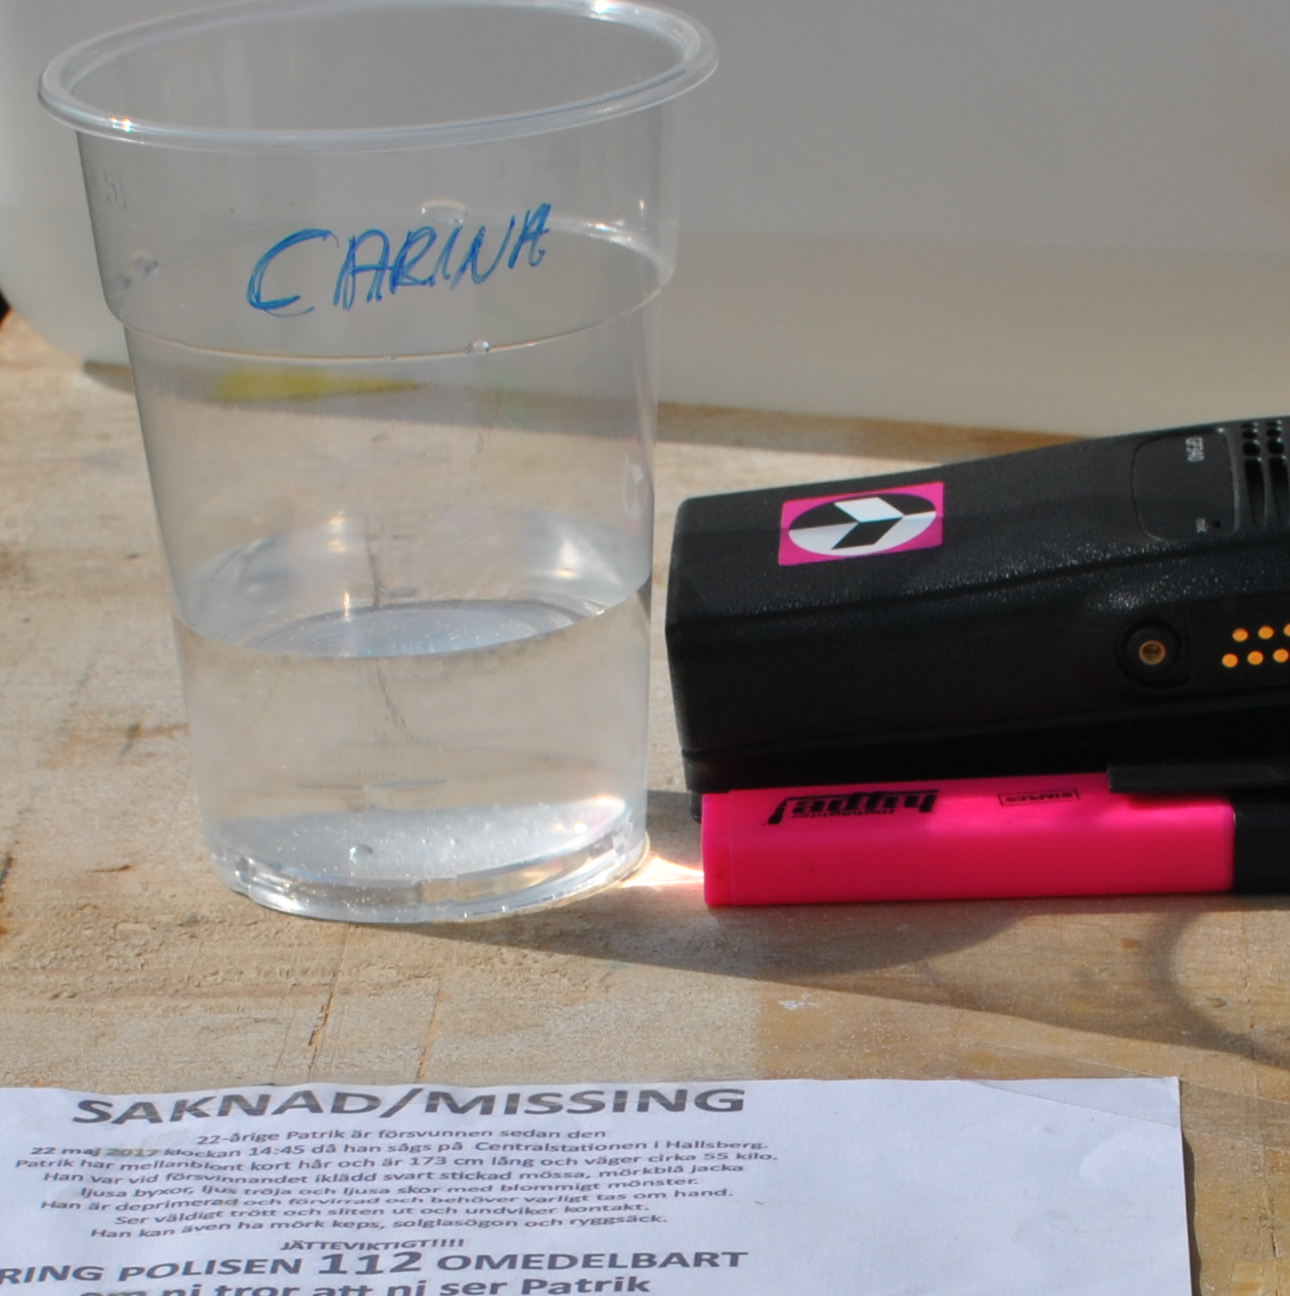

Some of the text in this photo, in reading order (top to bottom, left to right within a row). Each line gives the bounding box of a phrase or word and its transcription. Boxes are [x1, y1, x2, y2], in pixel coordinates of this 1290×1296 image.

[246, 203, 551, 317] CARINA
[72, 1087, 746, 1125] SAKNAD/MISSING
[197, 1129, 606, 1145] 22-årige Patrik är försvunnen sedan den
[30, 1147, 56, 1155] 22
[62, 1148, 102, 1156] maj
[106, 1148, 159, 1157] 2017
[164, 1148, 241, 1158] klockan
[248, 1146, 305, 1156] 14:45
[311, 1145, 337, 1154] då
[344, 1144, 382, 1153] han
[387, 1143, 432, 1154] sågs
[438, 1143, 463, 1153] på
[474, 1142, 647, 1152] Centralstationen
[665, 1140, 768, 1150] Hallsberg.
[15, 1159, 74, 1168] Patrik
[80, 1160, 114, 1169] har
[120, 1161, 243, 1171] mellanblont
[250, 1161, 291, 1171] kort
[298, 1160, 333, 1169] hår
[338, 1159, 375, 1168] och
[382, 1158, 403, 1167] är
[409, 1157, 447, 1166] 173
[454, 1158, 484, 1166] cm
[491, 1156, 535, 1168] lång
[541, 1157, 578, 1166] och
[584, 1156, 642, 1166] väger
[648, 1154, 696, 1162] cirka
[735, 1152, 777, 1161] kilo.
[43, 1164, 744, 1184] Han var vid försvinnandet iklädd svart stickad mössa, mörkblå jacka
[80, 1178, 699, 1198] ljusa byxor, ljus tröja och ljusa skor med blommigt mönster.
[41, 1200, 82, 1210] Han
[88, 1202, 111, 1211] är
[115, 1198, 239, 1212] deprimerad
[289, 1197, 380, 1205] förvirrad
[430, 1195, 519, 1203] behöver
[524, 1194, 589, 1204] varligt
[634, 1191, 667, 1199] om
[674, 1189, 733, 1198] hand.
[115, 1203, 650, 1224] Ser väldigt trött och sliten ut och undviker kontakt.
[91, 1214, 667, 1237] Han kan även ha mörk keps, solglasögon och ryggsäck.
[280, 1238, 465, 1251] JÄTTEVIKTIGT!!!!
[118, 1258, 304, 1282] POLISEN
[316, 1250, 424, 1276] 112
[436, 1252, 748, 1271] OMEDELBART
[439, 1280, 508, 1296] ser
[520, 1276, 651, 1295] Patrik
